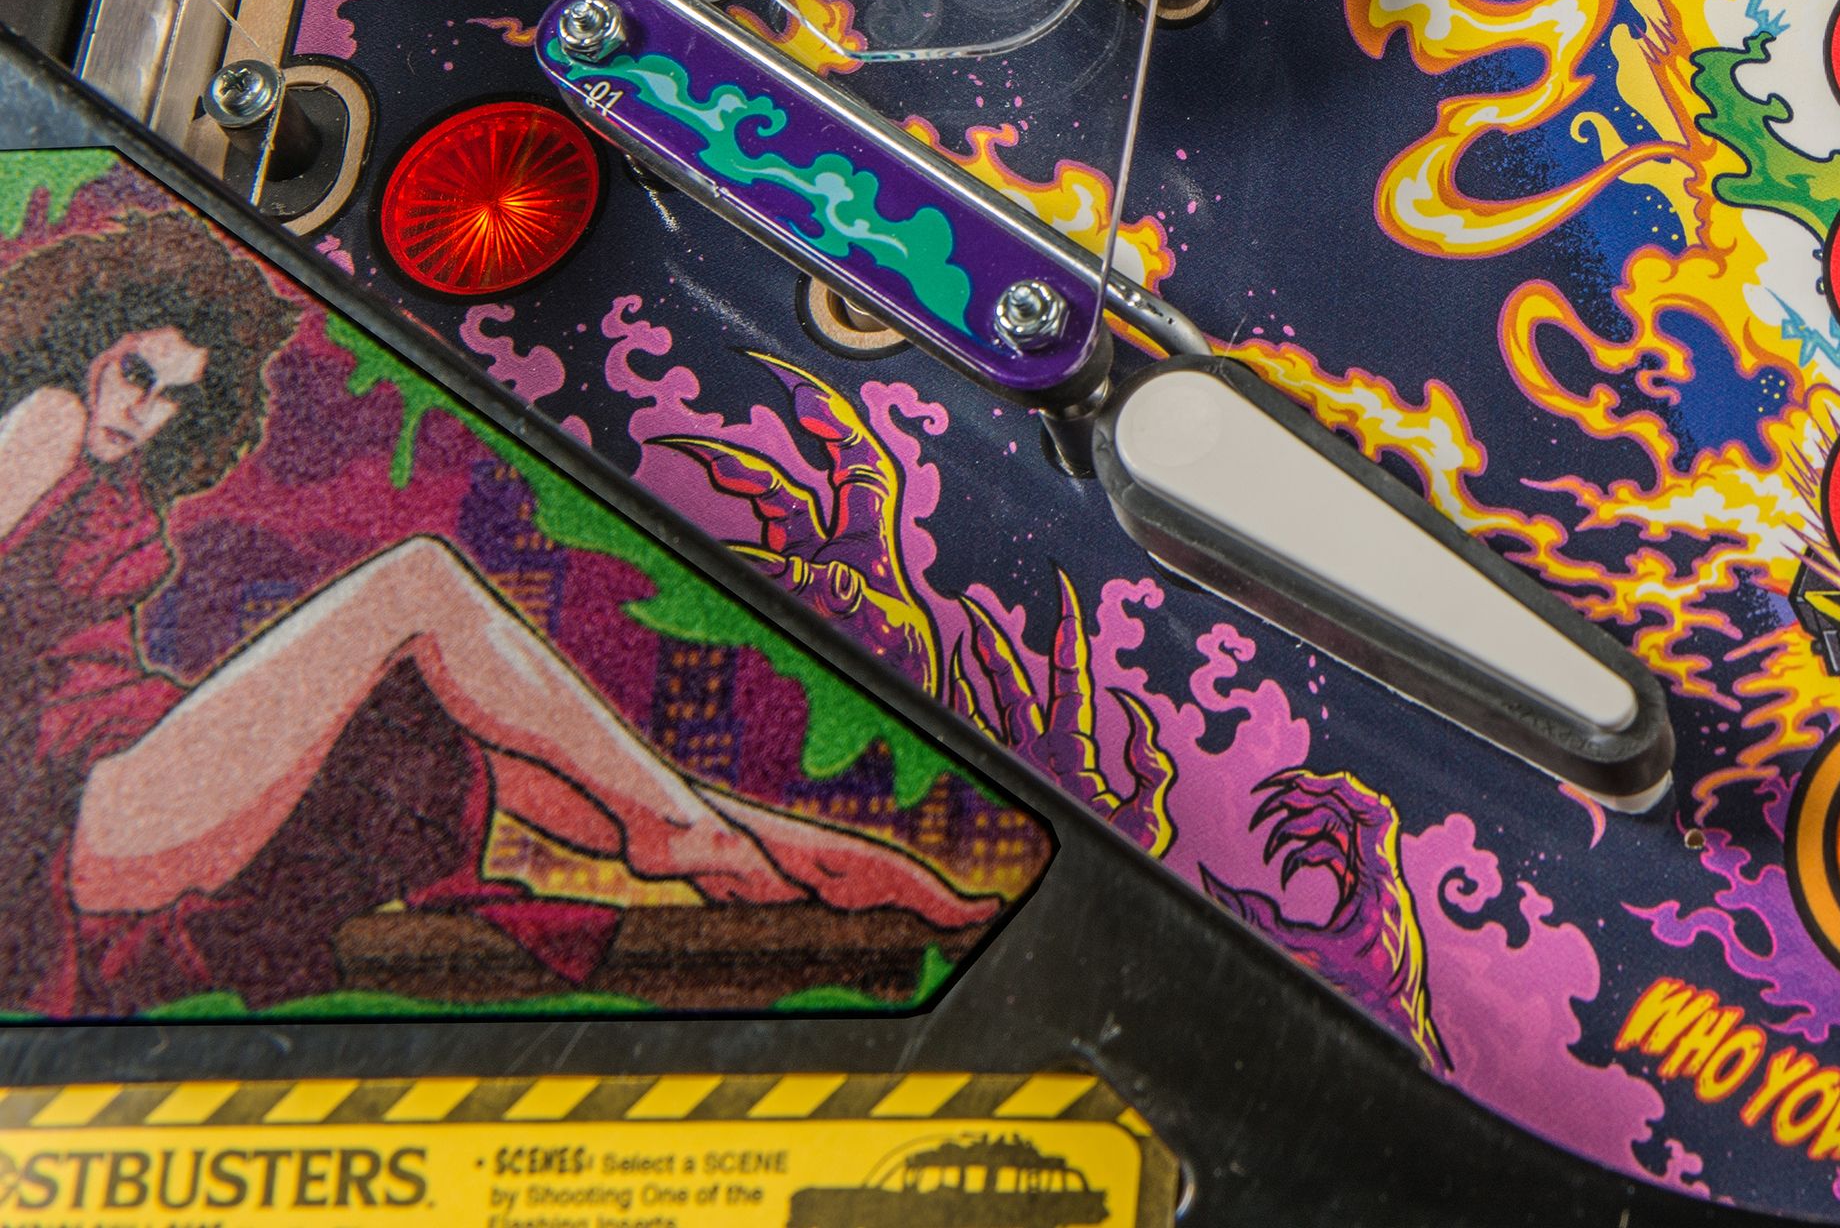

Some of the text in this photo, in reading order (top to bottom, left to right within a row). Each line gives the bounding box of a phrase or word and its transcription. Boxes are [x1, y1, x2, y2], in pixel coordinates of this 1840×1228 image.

[1616, 978, 1766, 1104] WHO
[601, 1151, 675, 1174] Select
[683, 1155, 696, 1174] a
[704, 1149, 789, 1174] SCENE
[490, 1184, 764, 1213] by Shooting One of the
